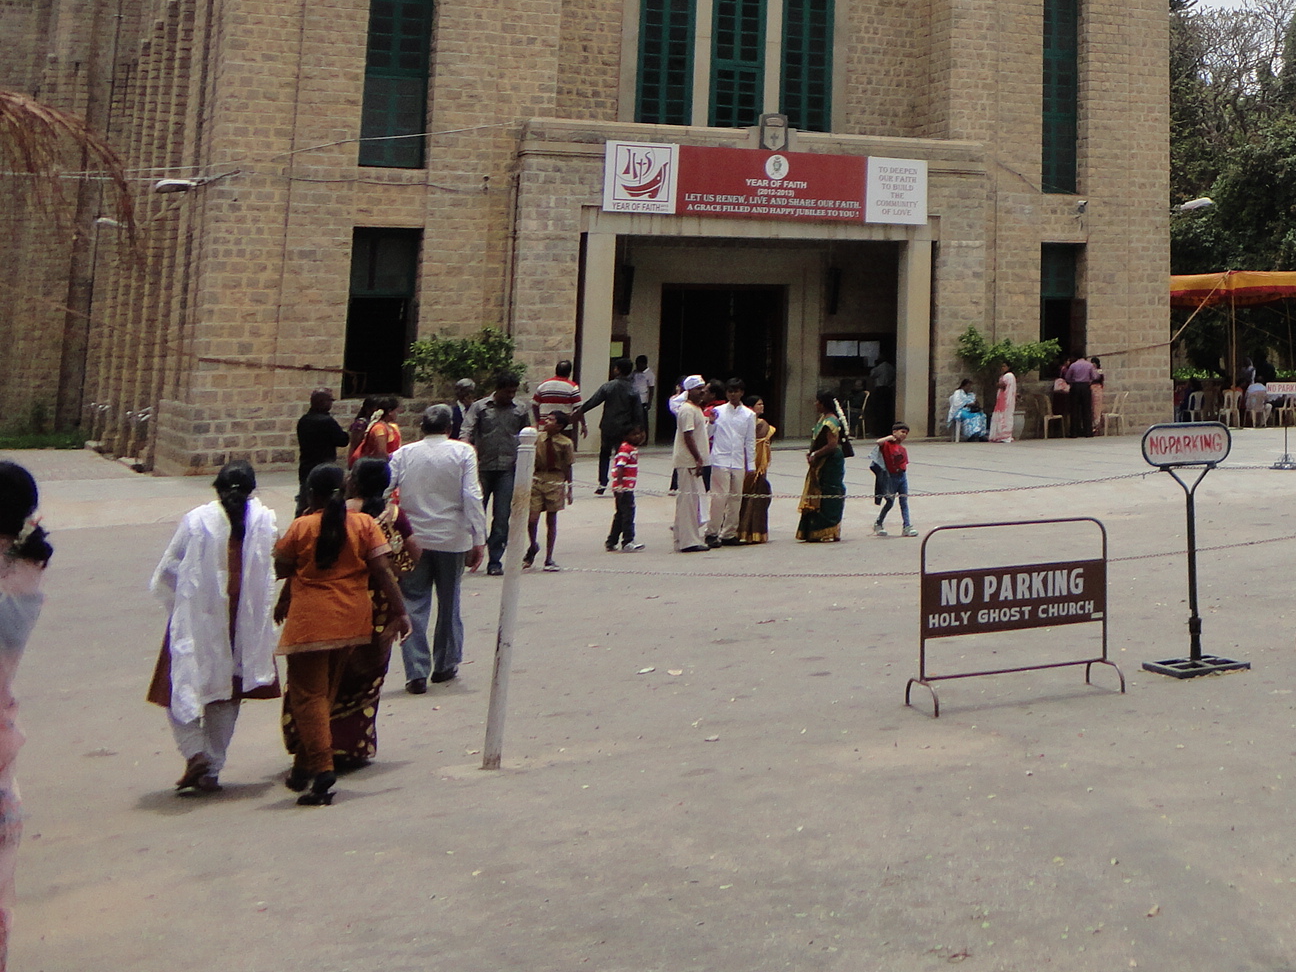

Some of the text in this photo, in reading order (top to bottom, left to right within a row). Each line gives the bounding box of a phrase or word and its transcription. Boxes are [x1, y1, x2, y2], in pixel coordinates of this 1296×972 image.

[890, 167, 918, 175] DEEPEN
[746, 178, 769, 187] YEAR
[770, 180, 782, 188] OF
[758, 188, 794, 197] (2012-2013)
[685, 193, 702, 201] LET
[703, 194, 714, 202] US
[749, 196, 768, 204] LIVE
[788, 198, 816, 207] SHARE
[817, 200, 834, 208] OUR
[876, 200, 918, 208] COMMUNITY
[612, 202, 630, 210] YEAR
[642, 203, 660, 211] FAITH
[694, 204, 721, 212] GRACE
[722, 205, 750, 213] FILLED
[770, 207, 796, 215] HAPPY
[795, 208, 826, 216] JUBILEE
[1268, 384, 1276, 392] NO
[940, 567, 1084, 606] NO PARKING
[928, 600, 1094, 629] HOLY GHOST CHURCH
